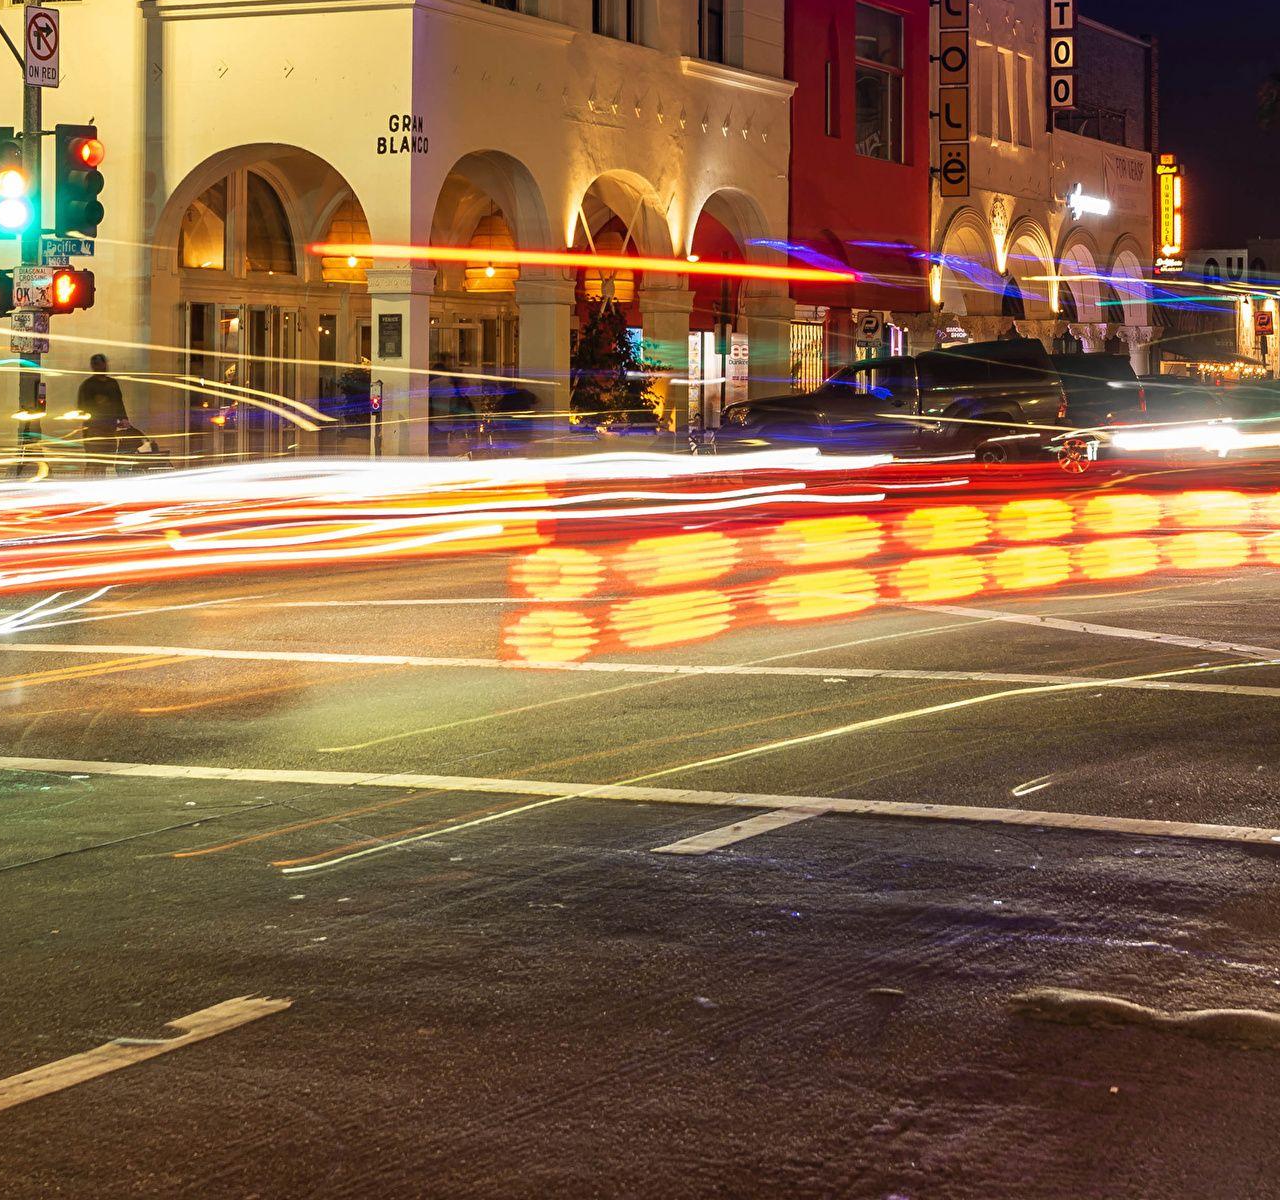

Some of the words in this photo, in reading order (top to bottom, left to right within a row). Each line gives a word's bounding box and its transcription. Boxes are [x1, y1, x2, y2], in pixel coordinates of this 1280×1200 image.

[28, 64, 40, 78] ON
[41, 66, 57, 81] RED
[388, 114, 423, 133] GRAN
[376, 135, 429, 155] BLANCO
[46, 240, 77, 253] Pacific
[16, 287, 31, 302] OK
